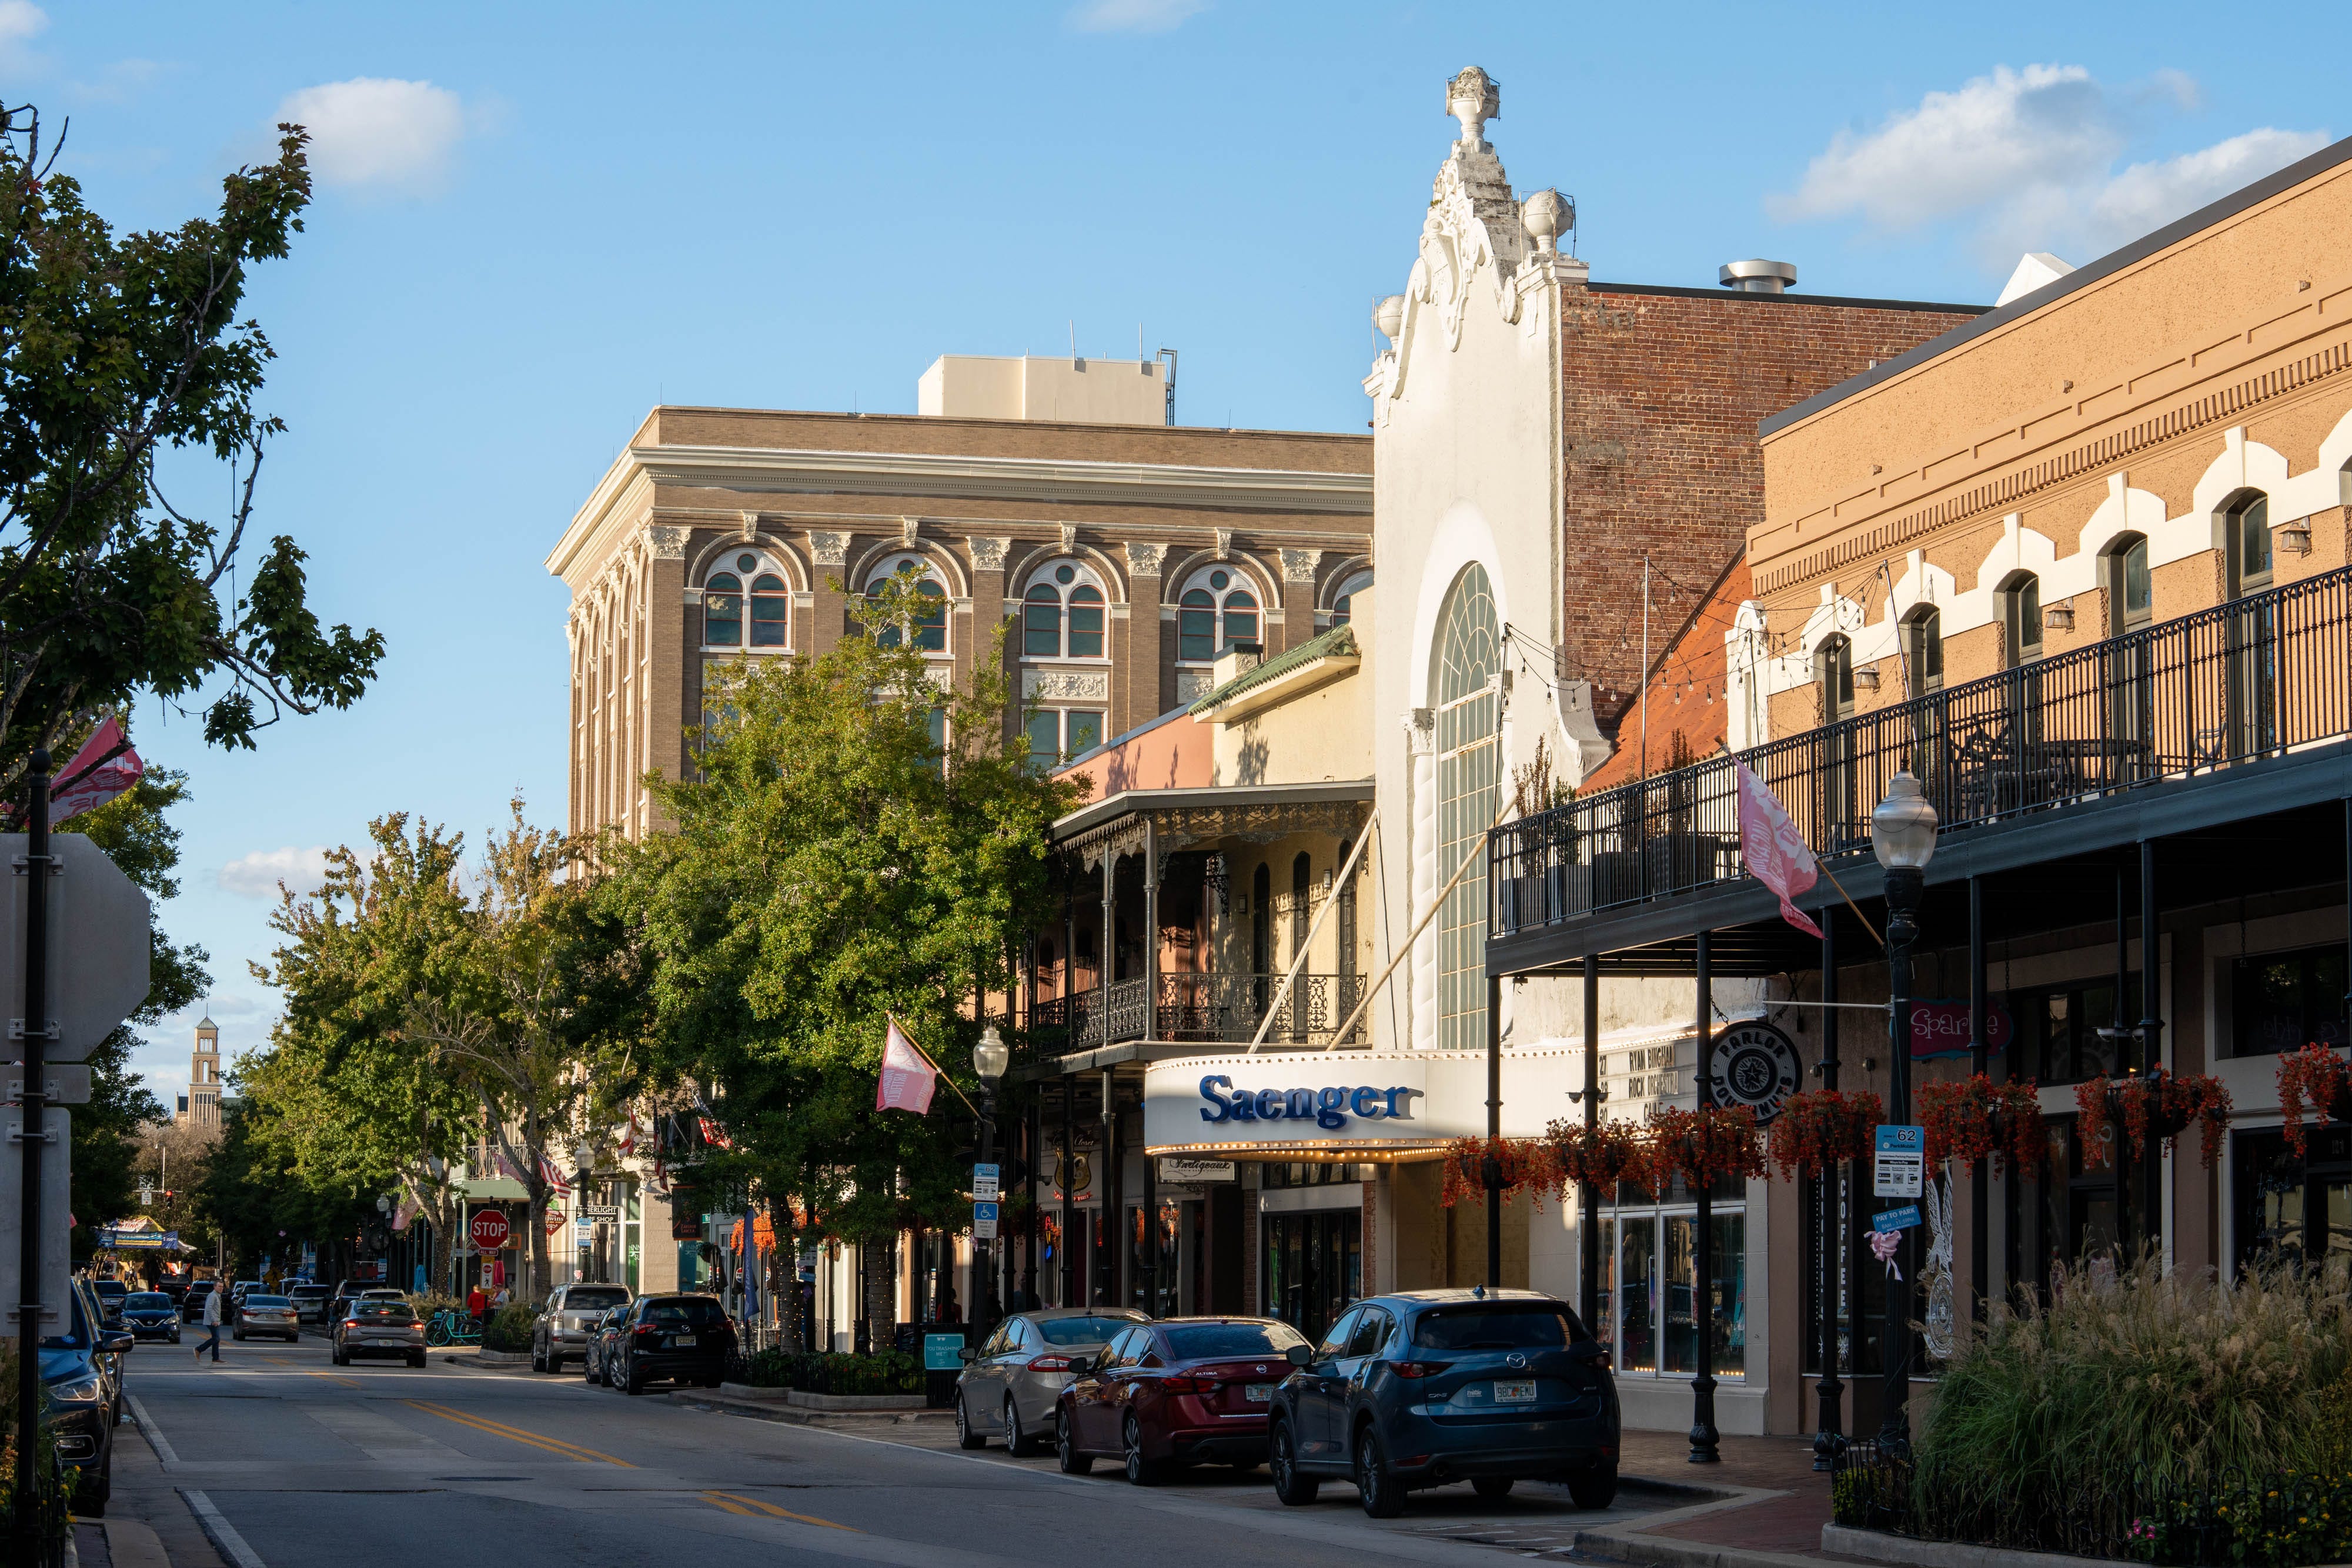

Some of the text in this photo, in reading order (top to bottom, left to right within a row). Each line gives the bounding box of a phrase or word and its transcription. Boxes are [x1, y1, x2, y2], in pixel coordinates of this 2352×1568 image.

[1910, 1008, 1999, 1039] Spare
[1719, 1031, 1785, 1058] PARLOR
[1599, 1055, 1606, 1075] 27
[1629, 1050, 1646, 1072] RYAN
[1629, 1072, 1678, 1098] ROCK ORCHESTRA
[1200, 1075, 1409, 1129] Saenger
[1897, 1129, 1916, 1142] 62
[1899, 1207, 1915, 1215] PARK
[473, 1222, 506, 1237] STOP
